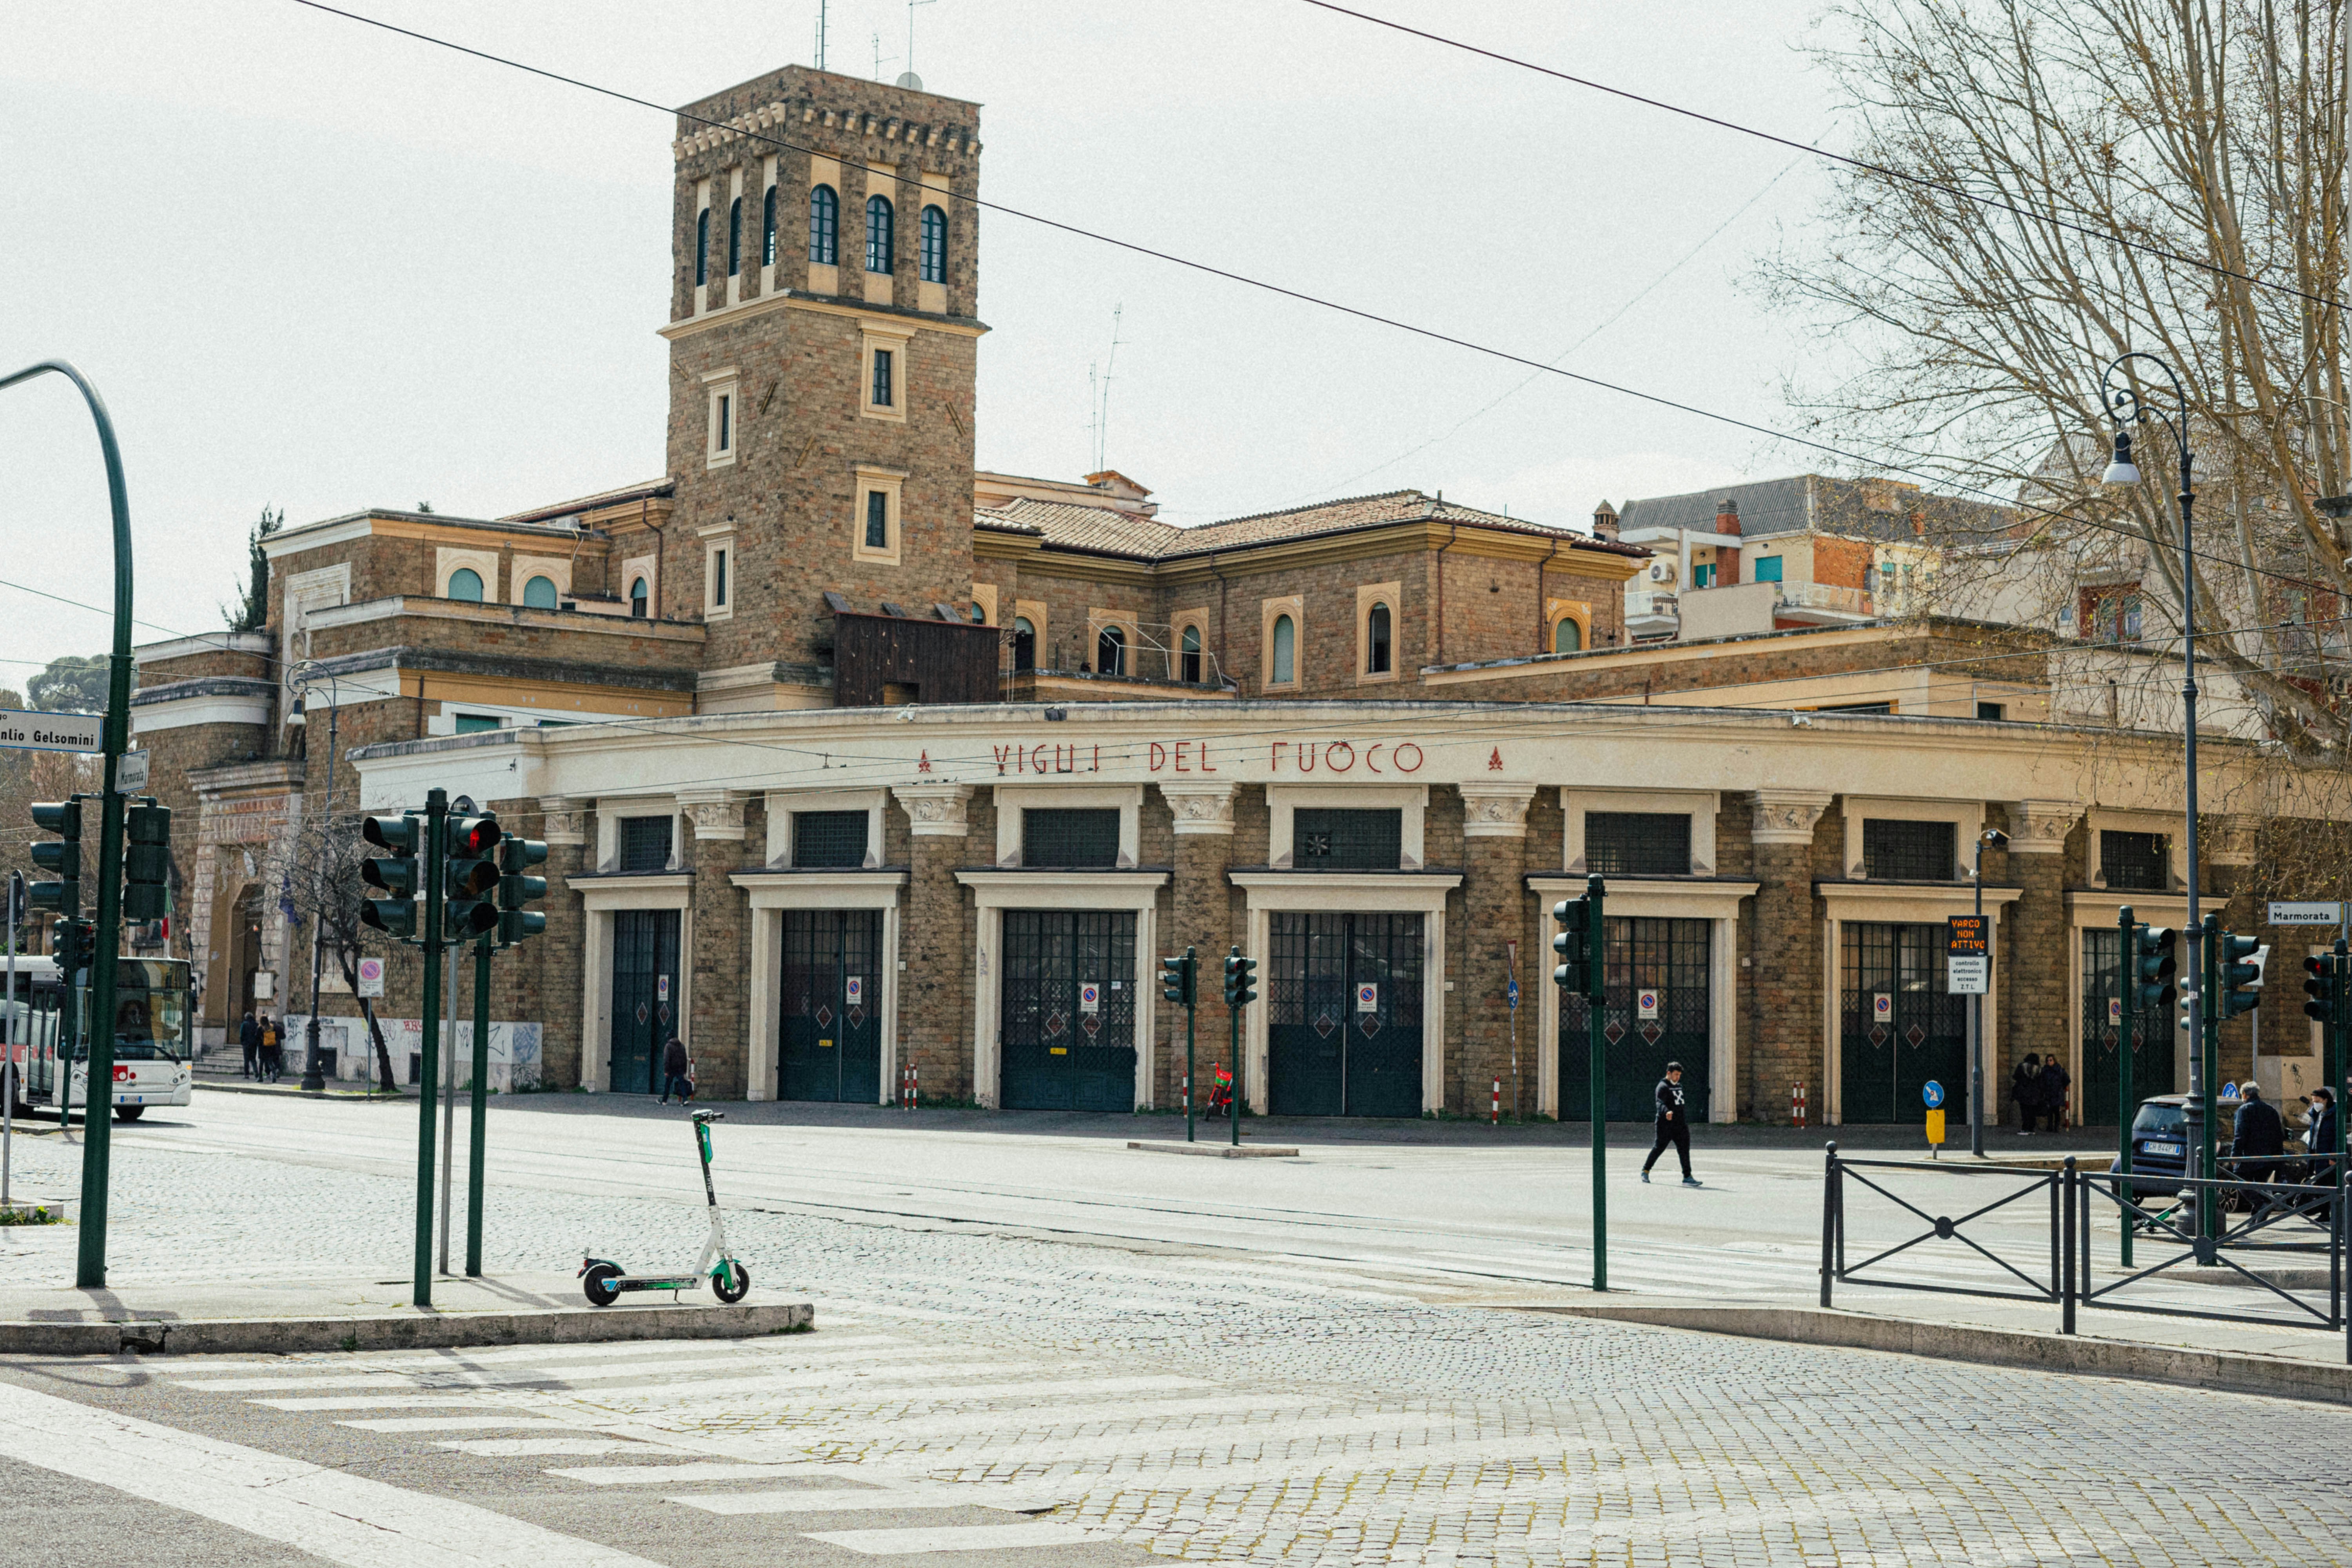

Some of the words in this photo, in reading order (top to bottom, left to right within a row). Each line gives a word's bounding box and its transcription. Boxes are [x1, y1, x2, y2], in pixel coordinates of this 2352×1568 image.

[34, 730, 94, 746] Gelsomini
[1151, 742, 1216, 771] DEL
[1272, 742, 1423, 773] FUOCO
[1957, 930, 1974, 938] NON
[1951, 940, 1985, 949] ATTIVO
